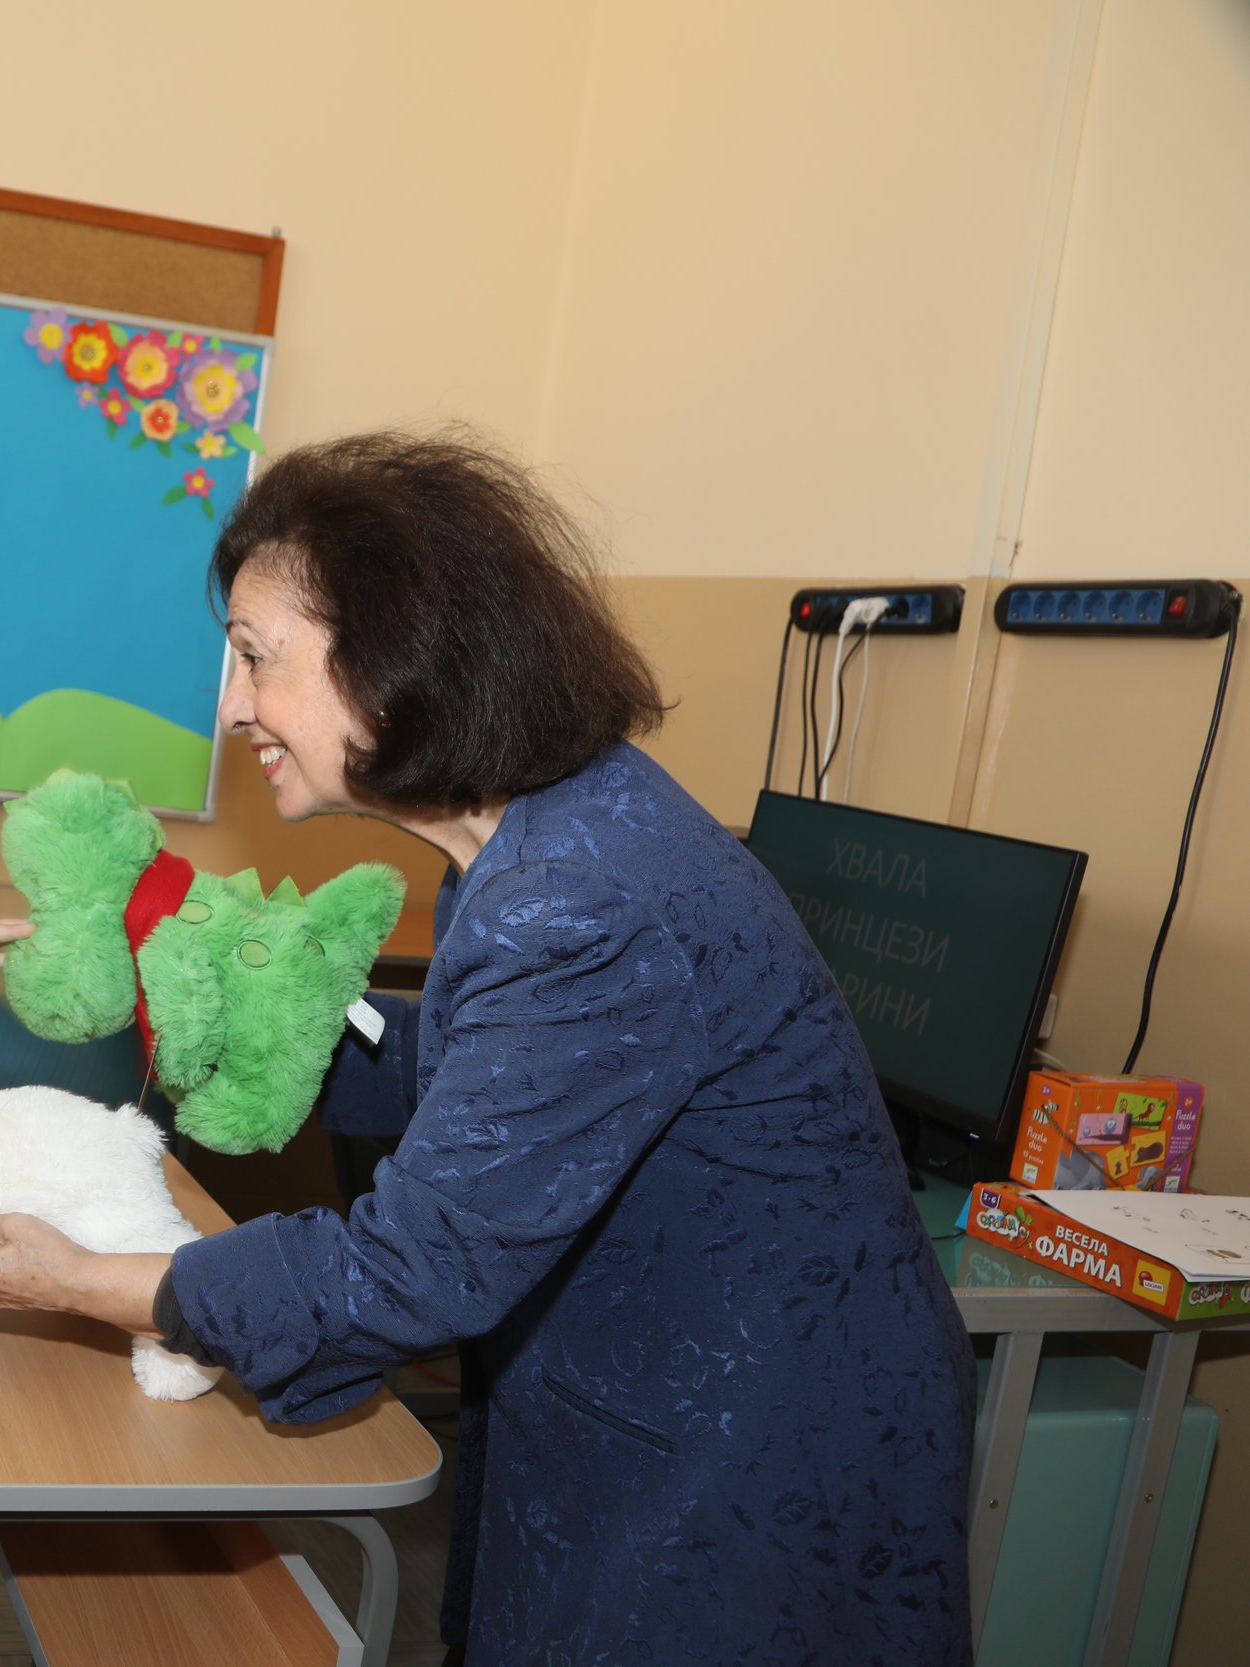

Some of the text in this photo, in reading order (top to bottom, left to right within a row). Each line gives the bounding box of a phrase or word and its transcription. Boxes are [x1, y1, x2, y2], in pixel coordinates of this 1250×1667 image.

[825, 838, 928, 897] ХВАЛА
[833, 968, 933, 1037] РИНИ
[1175, 1109, 1196, 1121] Puzzle
[1177, 1121, 1191, 1131] duo
[1026, 1126, 1048, 1144] Puzzle
[1029, 1140, 1043, 1152] duo
[1055, 1225, 1108, 1256] ВЕСЕЛА
[1035, 1235, 1122, 1288] ФАРМА
